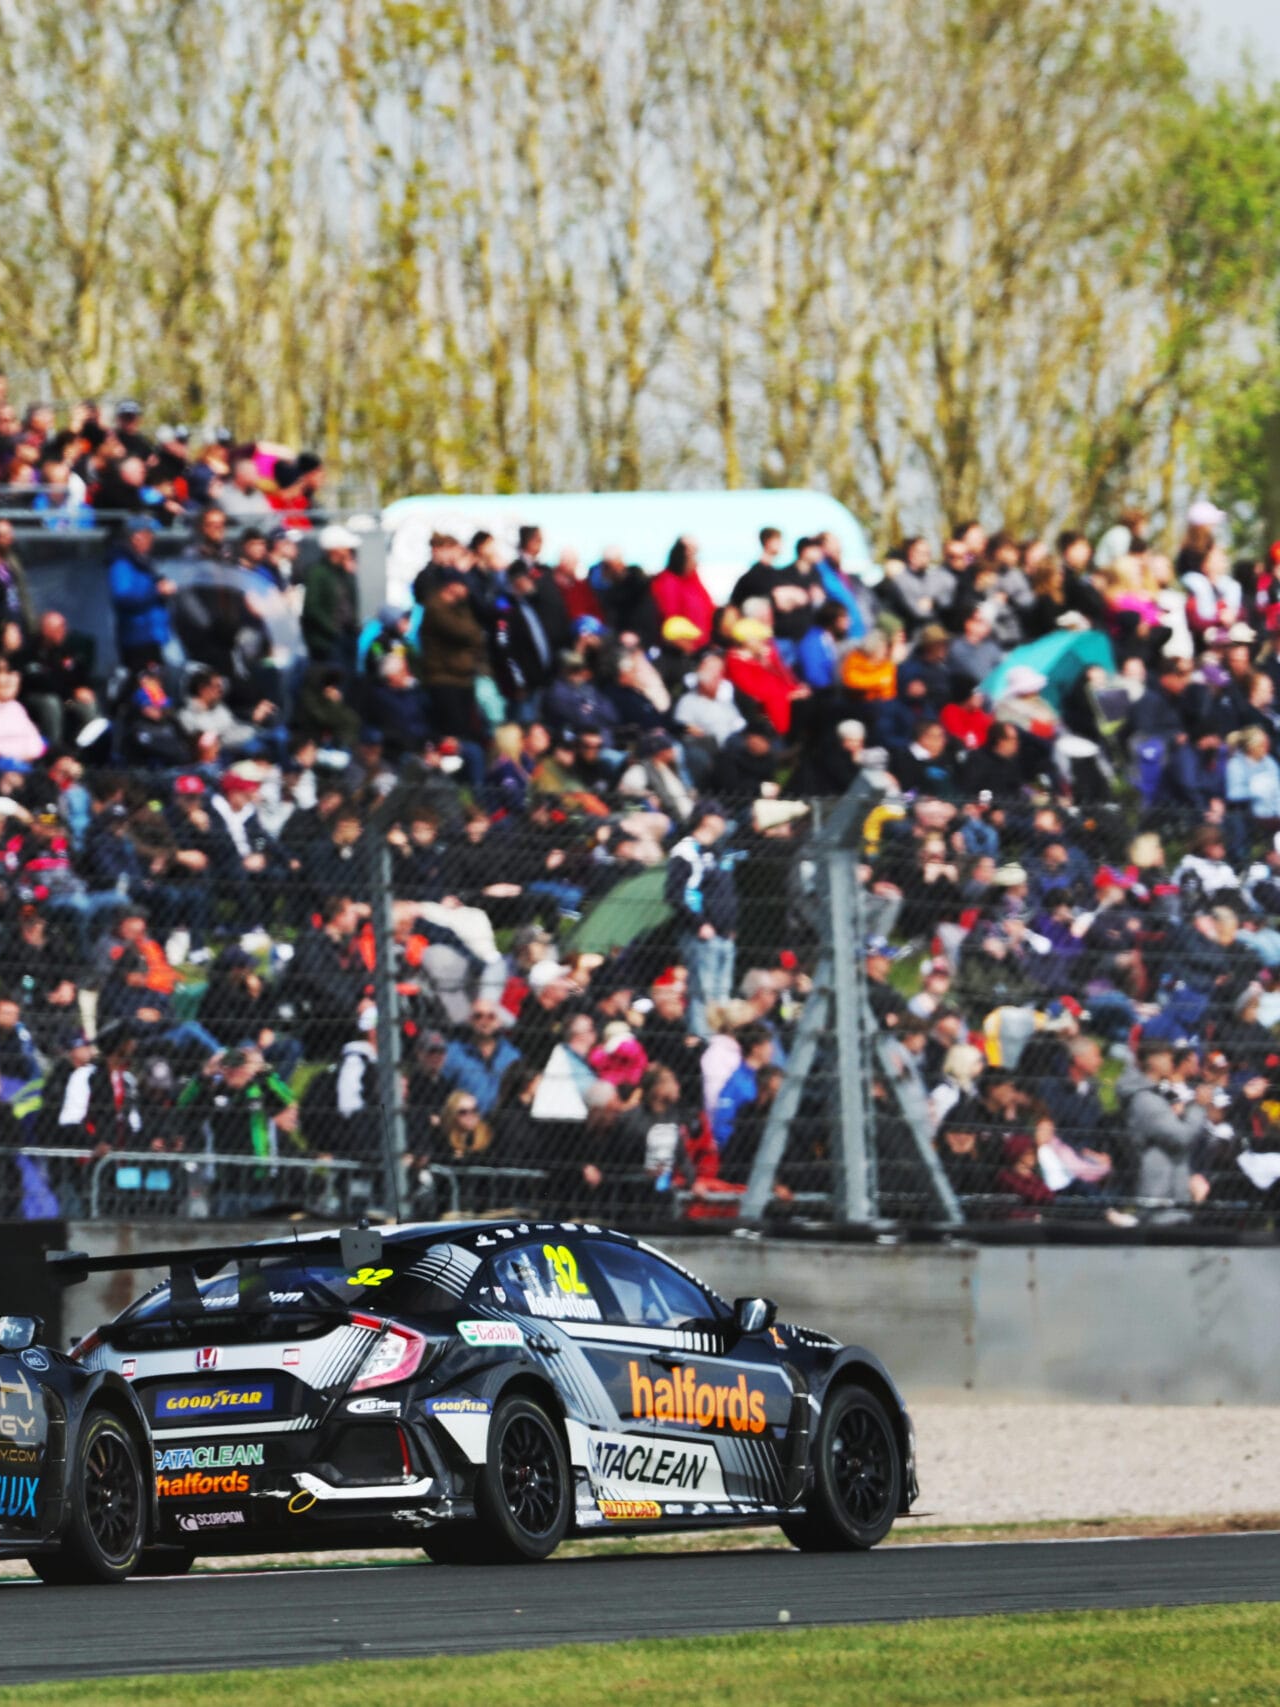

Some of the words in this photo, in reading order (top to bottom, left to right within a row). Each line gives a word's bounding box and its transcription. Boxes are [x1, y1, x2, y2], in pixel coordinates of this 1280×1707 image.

[346, 1268, 394, 1286] 32
[543, 1244, 589, 1294] 32
[166, 1390, 262, 1409] GOODYEAR
[432, 1400, 488, 1412] GOODYEAR
[629, 1361, 766, 1433] halfords
[156, 1470, 250, 1497] halfords
[197, 1511, 245, 1526] SCORPION
[604, 1502, 657, 1517] AUTOCAR
